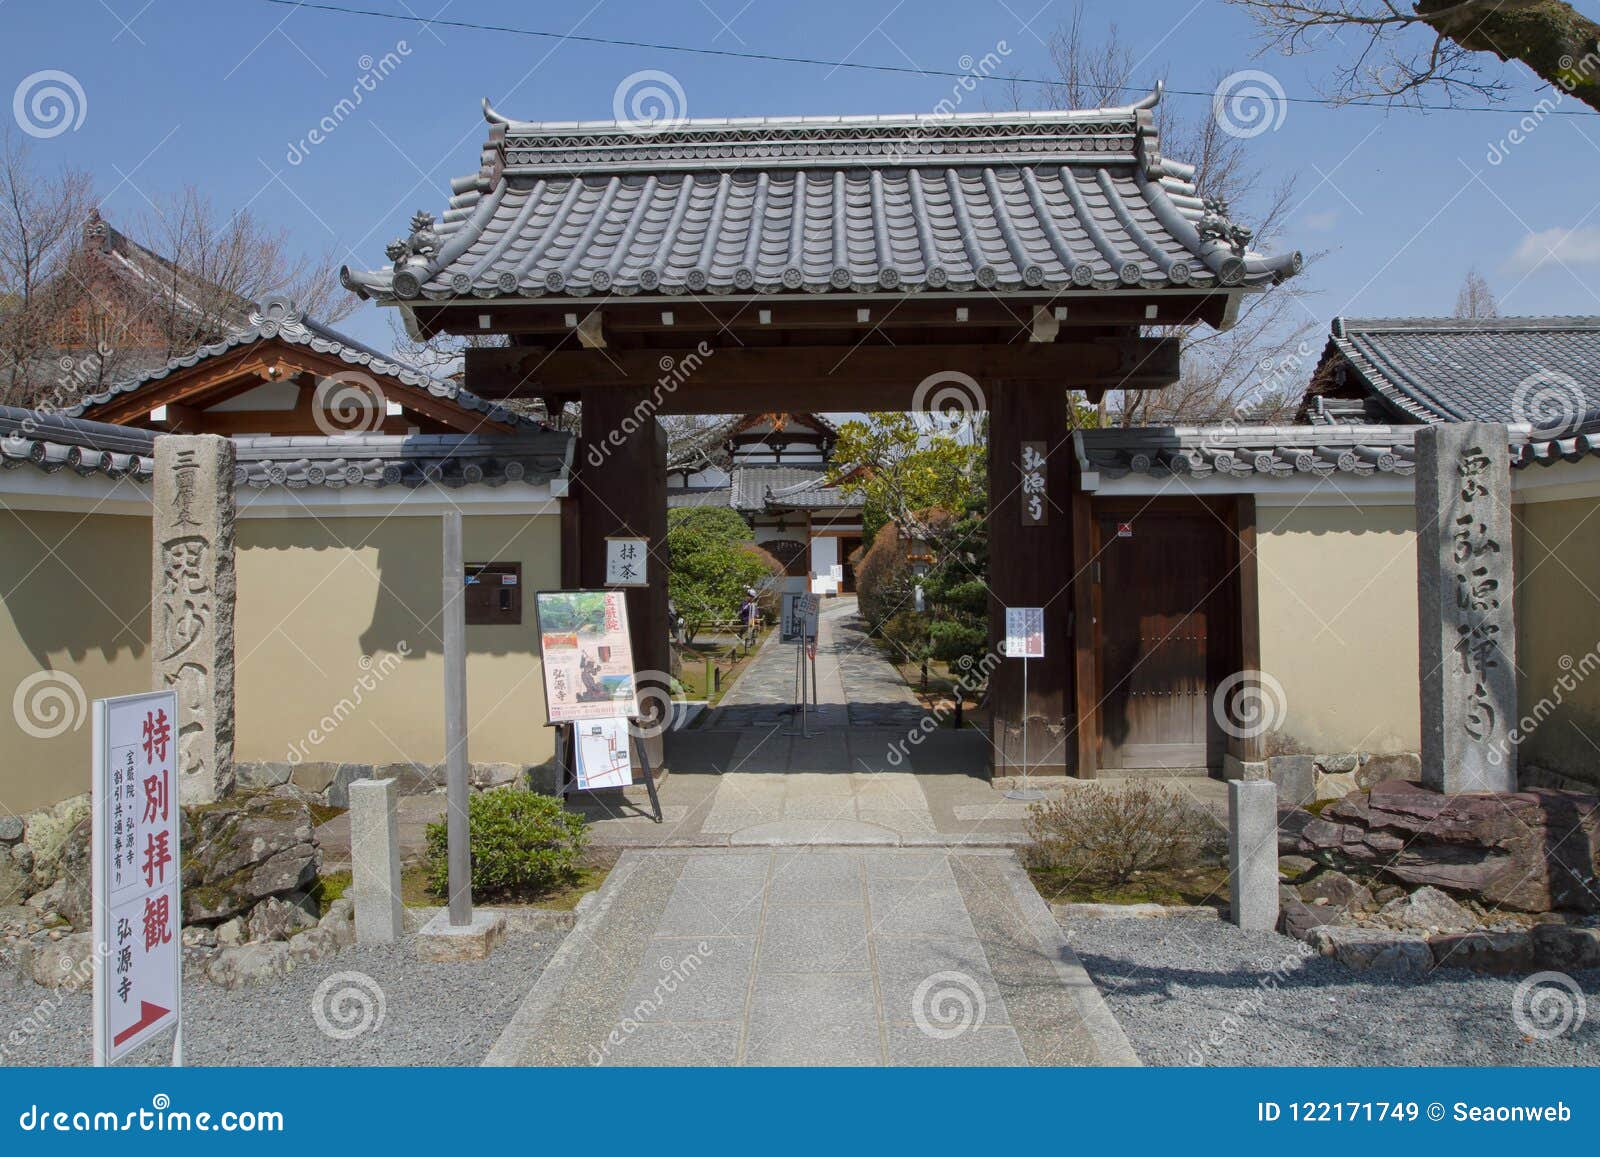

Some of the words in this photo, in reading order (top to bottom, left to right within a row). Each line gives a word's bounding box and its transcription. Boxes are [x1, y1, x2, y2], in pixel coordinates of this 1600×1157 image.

[620, 543, 638, 580] 抹茶
[142, 708, 173, 953] 特別拝観
[116, 918, 133, 1004] 弘源寺
